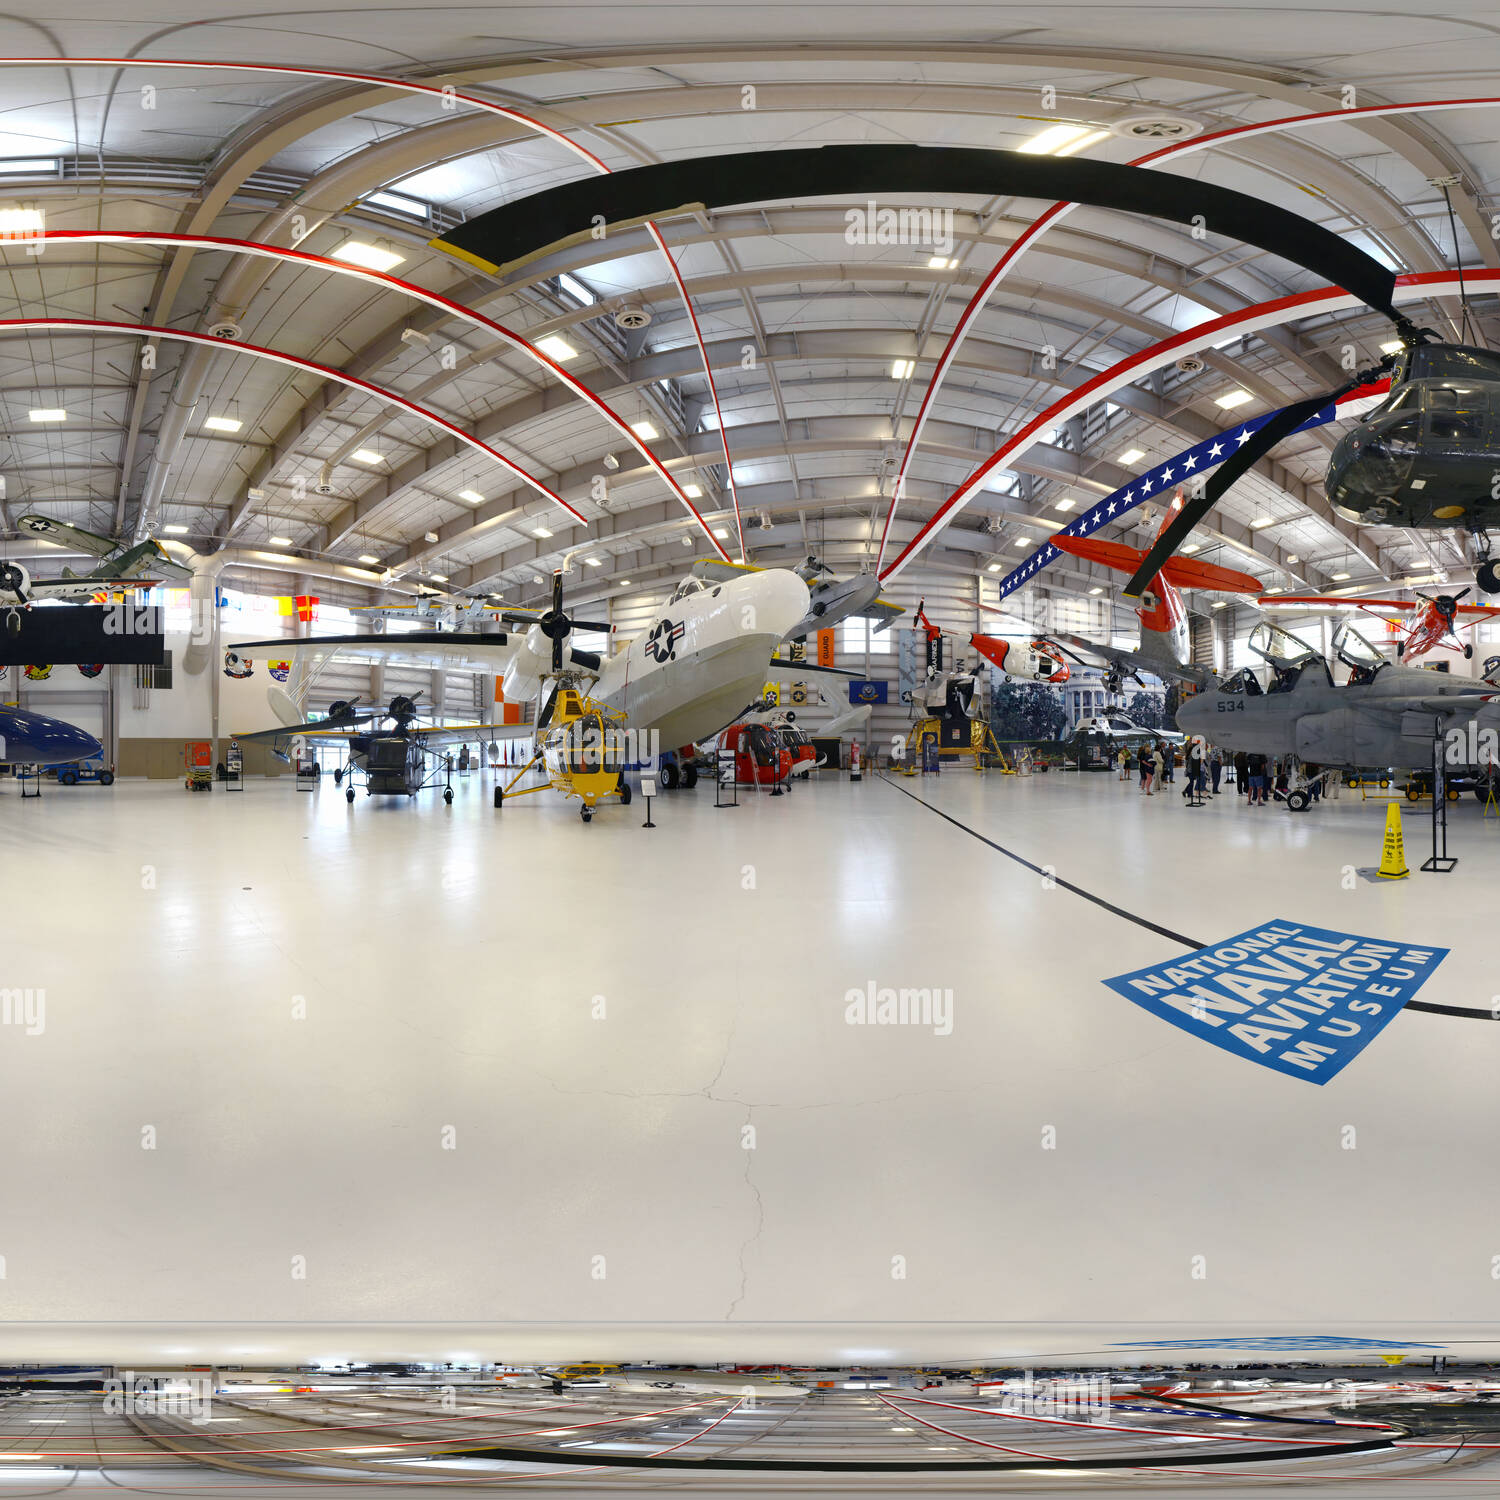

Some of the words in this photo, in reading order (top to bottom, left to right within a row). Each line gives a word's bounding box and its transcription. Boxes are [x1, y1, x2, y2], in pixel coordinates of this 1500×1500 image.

[1216, 700, 1245, 713] 534
[1127, 925, 1303, 996] NATIONAL
[1159, 936, 1359, 1029] NAVAL
[1227, 943, 1400, 1055] AVIATION
[1278, 950, 1435, 1071] MUSEUM
